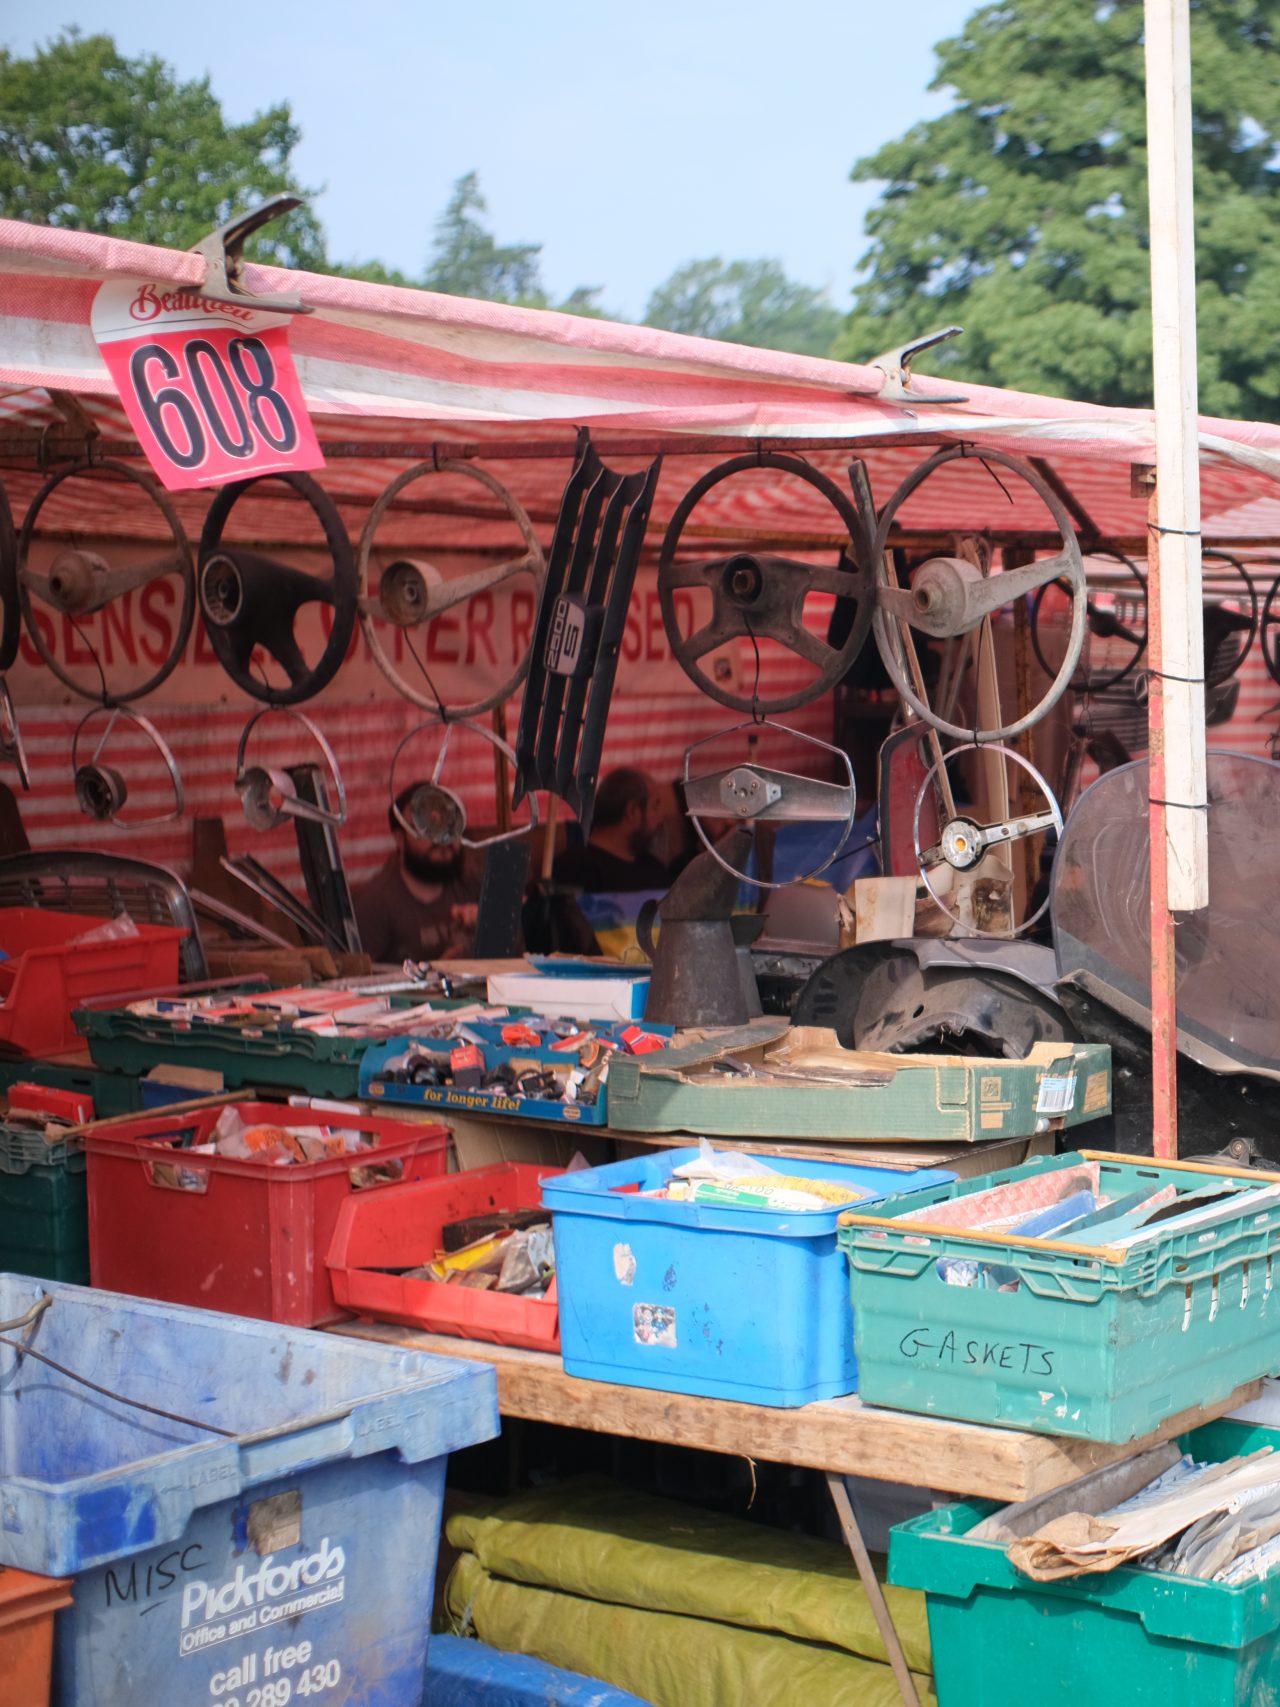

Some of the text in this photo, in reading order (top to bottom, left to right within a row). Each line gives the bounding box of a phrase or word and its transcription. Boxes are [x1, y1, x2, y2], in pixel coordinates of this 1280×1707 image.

[130, 337, 300, 470] 608
[547, 599, 567, 668] 2500
[424, 1088, 521, 1111] for longer life!
[900, 1328, 1055, 1375] GASKETS
[187, 1464, 237, 1490] LABEL
[105, 1544, 209, 1607] MISC
[181, 1537, 346, 1629] Pickfords
[182, 1578, 344, 1652] Office and Commercial
[210, 1640, 312, 1695] call free
[296, 1659, 341, 1697] 430
